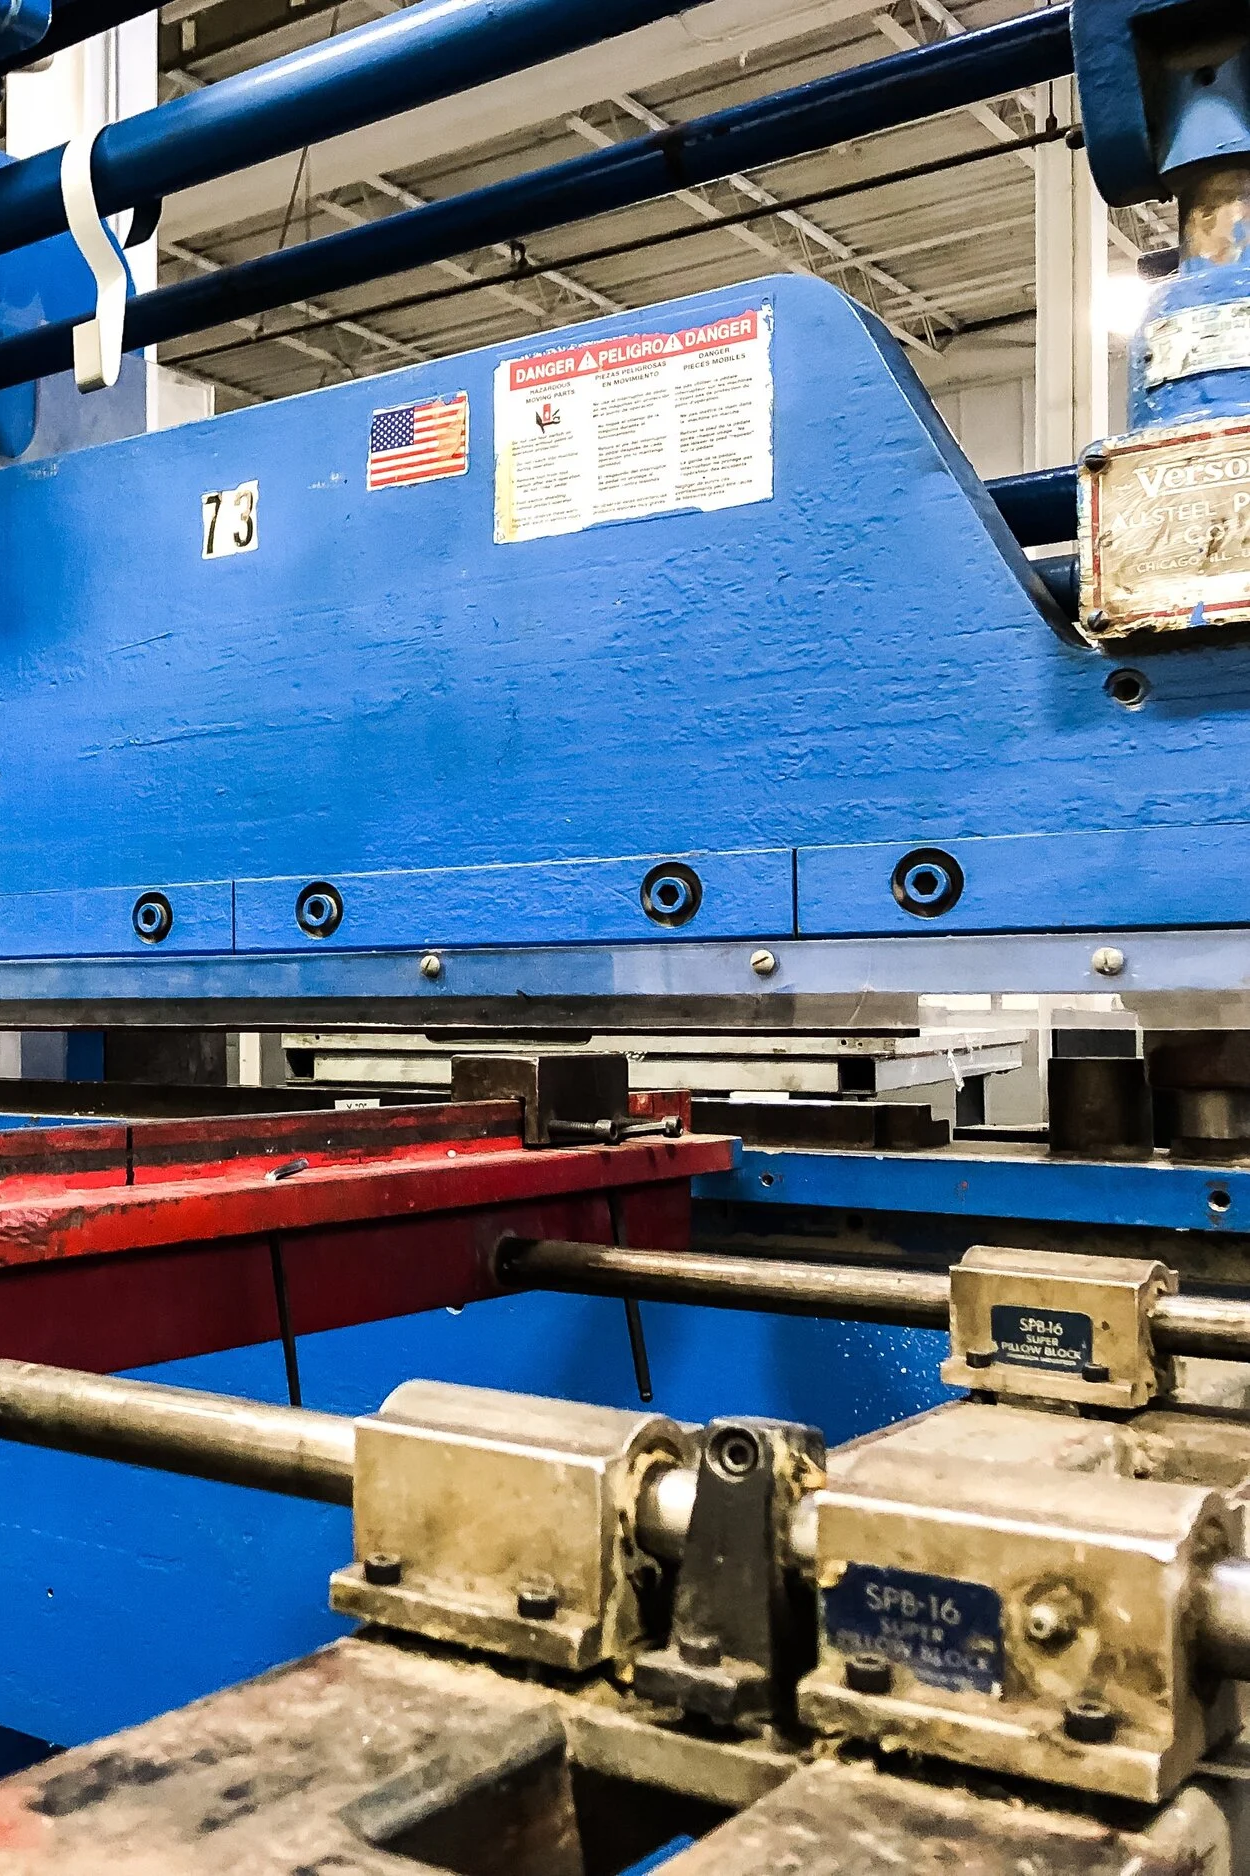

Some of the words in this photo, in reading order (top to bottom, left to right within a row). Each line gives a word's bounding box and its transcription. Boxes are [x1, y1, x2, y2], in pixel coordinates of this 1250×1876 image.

[515, 358, 575, 384] DANGER
[598, 338, 664, 366] PELIGRO
[684, 319, 752, 347] DANGER
[698, 346, 730, 359] DANGER
[594, 370, 620, 381] PIEZAS
[621, 360, 667, 375] PELIGROSAS
[683, 357, 710, 371] PIECES
[712, 352, 746, 364] MOBILES
[530, 381, 571, 395] HAZARDOUS
[613, 371, 659, 386] MOVIMIENTO
[525, 393, 552, 404] MOVING
[553, 389, 575, 399] PARTS
[1133, 457, 1250, 498] Verso
[205, 491, 254, 554] 73
[1019, 1317, 1064, 1336] SPB-16
[1025, 1333, 1059, 1347] SUPER
[1001, 1341, 1043, 1356] PILLOW
[1044, 1346, 1082, 1360] BLOCK
[864, 1581, 962, 1626] SPB-16
